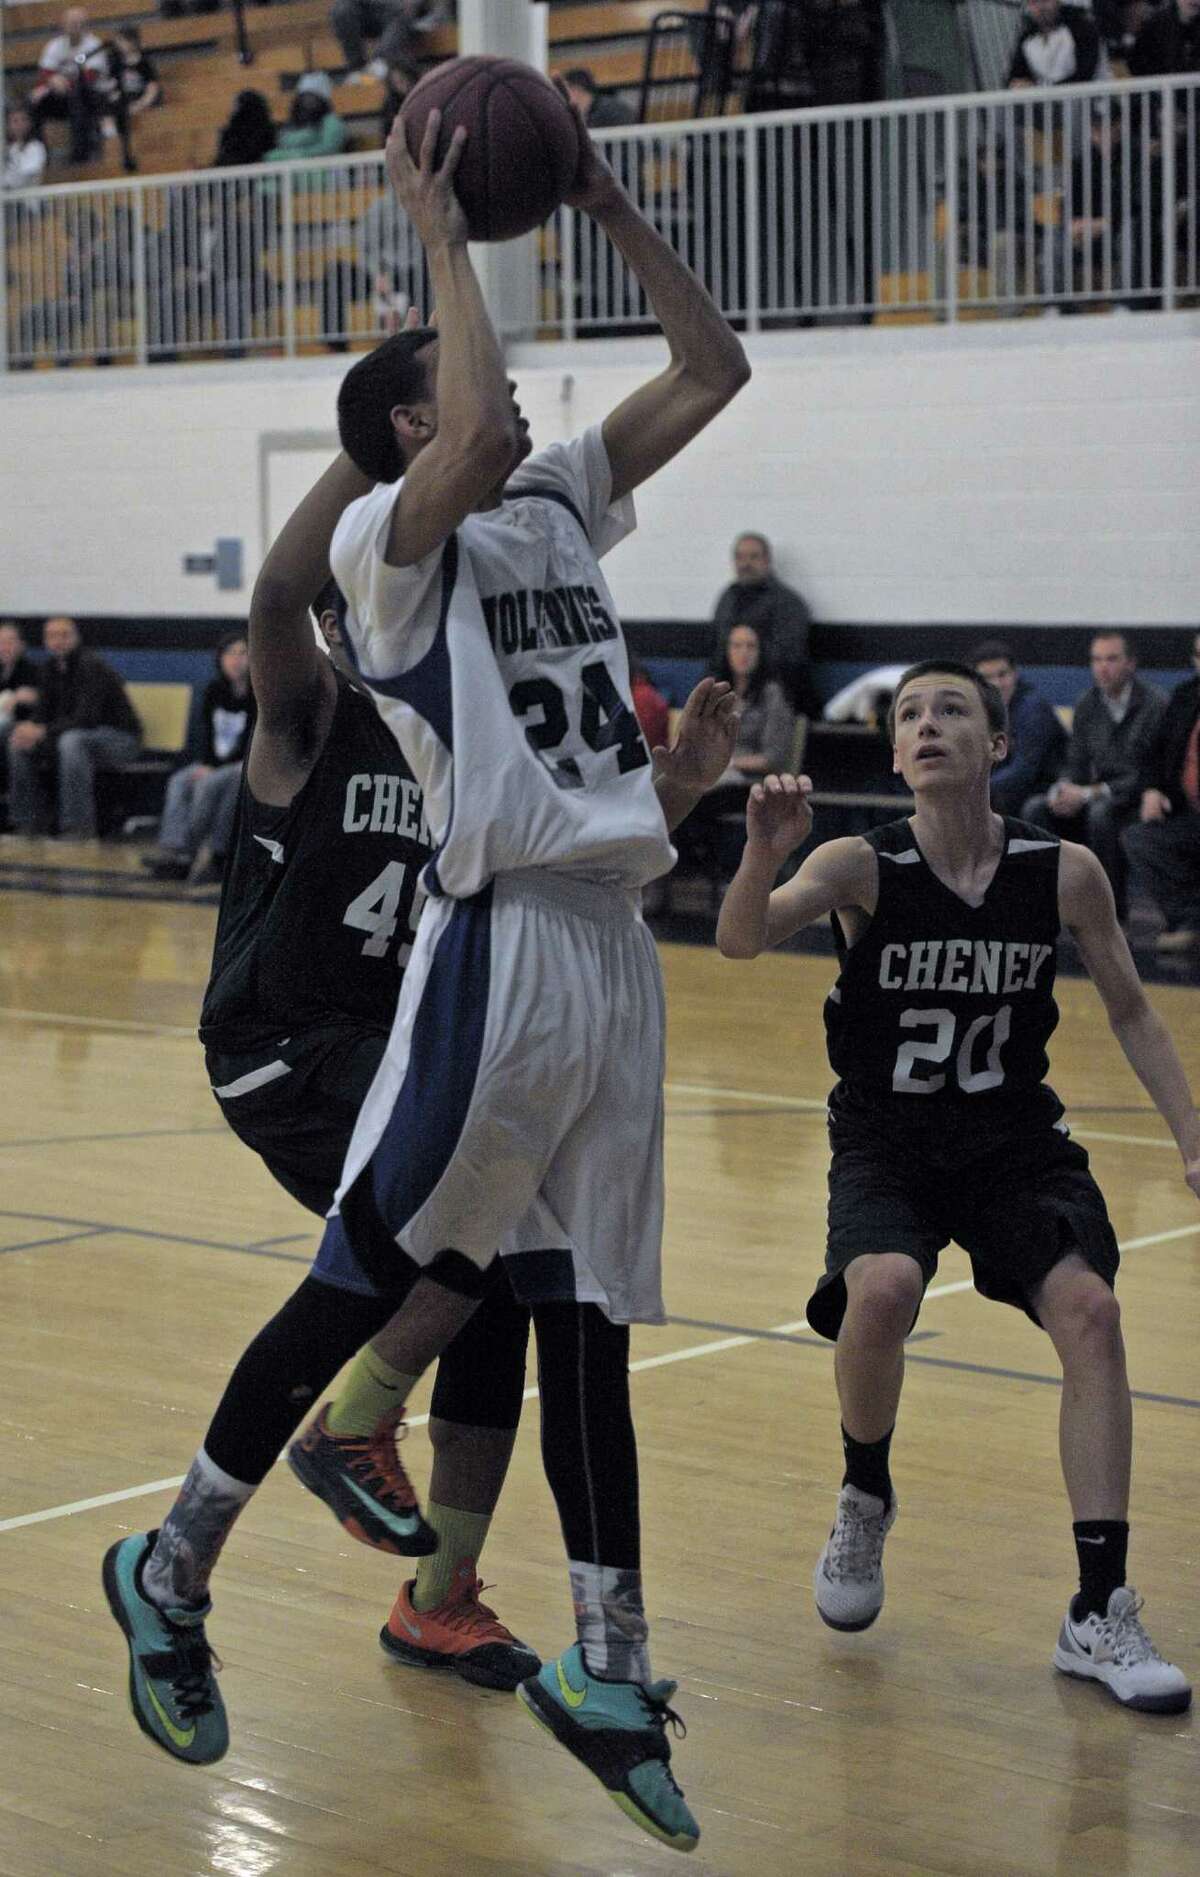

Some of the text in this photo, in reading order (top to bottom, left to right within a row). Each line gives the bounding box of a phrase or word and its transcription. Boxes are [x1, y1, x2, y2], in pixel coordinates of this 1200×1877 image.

[508, 661, 650, 789] 24
[342, 773, 438, 851] CHE
[878, 939, 1053, 994] CHENEY
[892, 1004, 1012, 1094] 20
